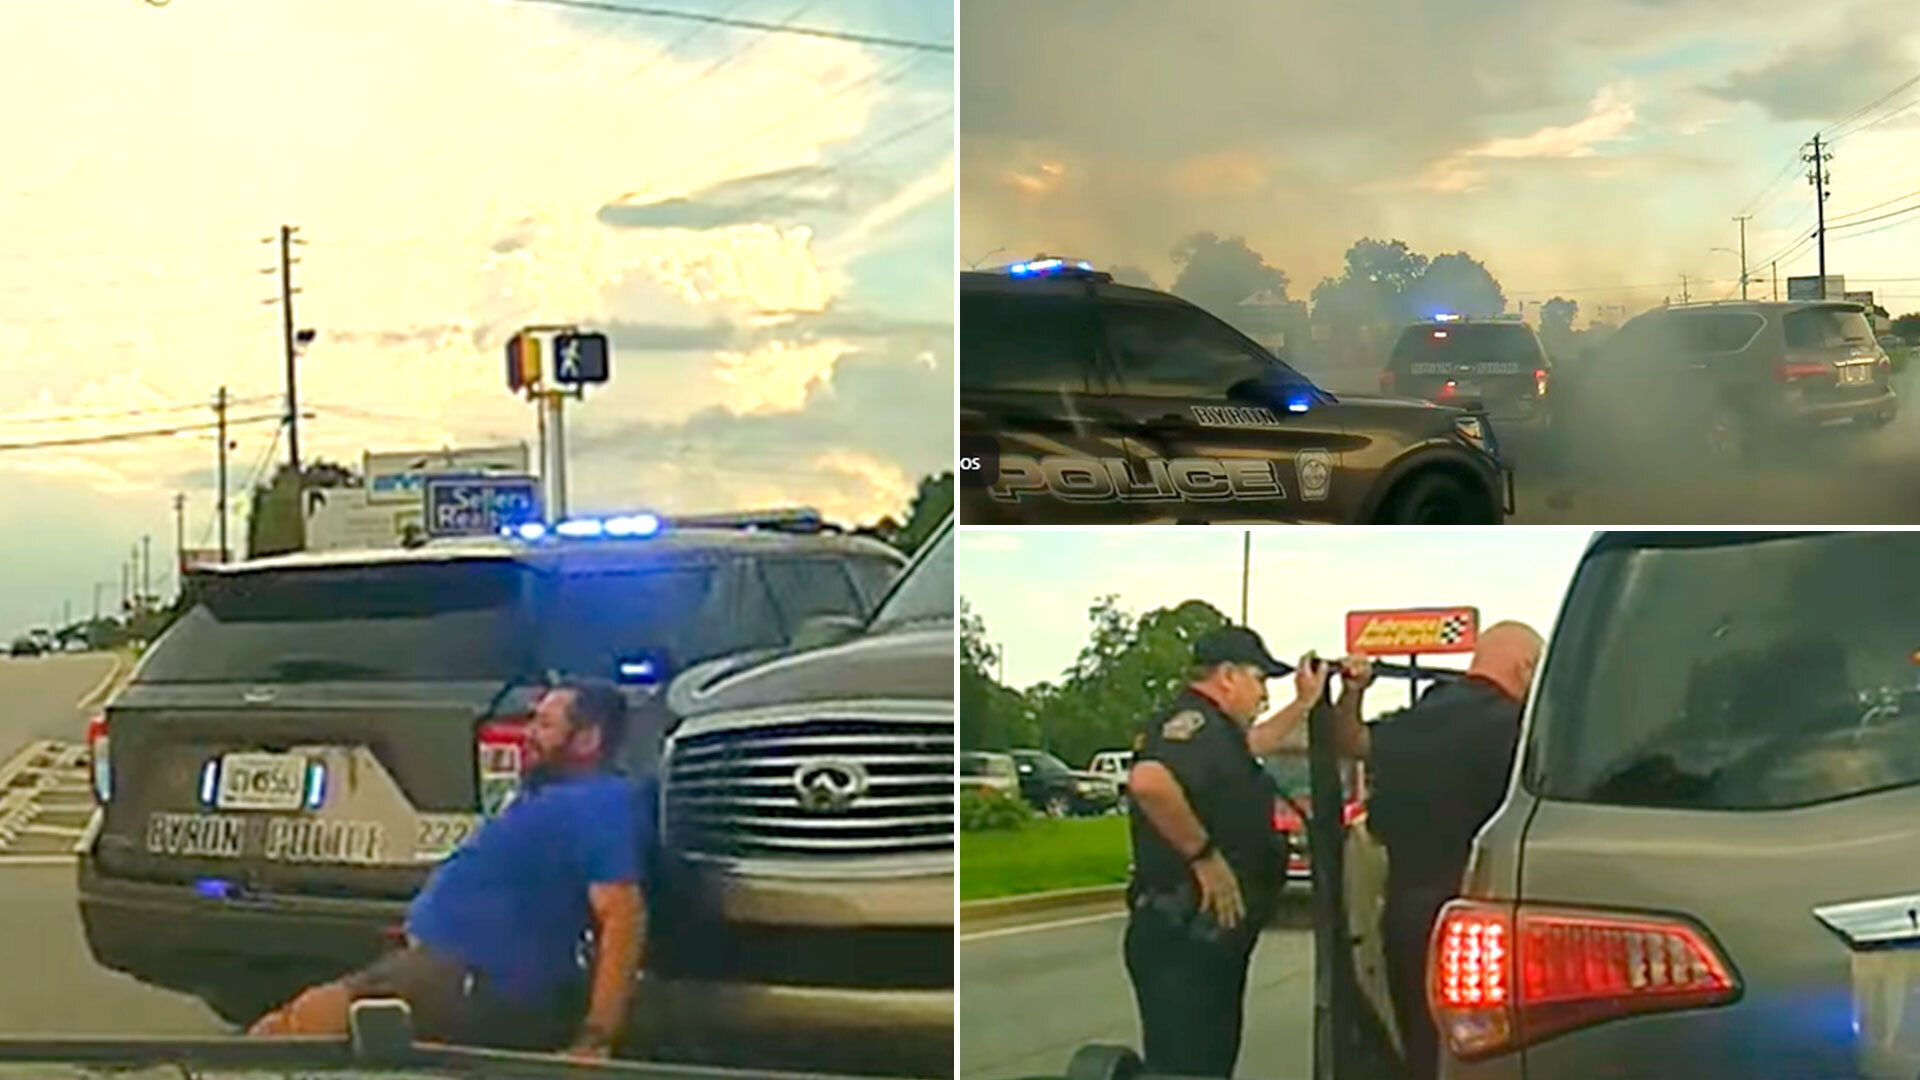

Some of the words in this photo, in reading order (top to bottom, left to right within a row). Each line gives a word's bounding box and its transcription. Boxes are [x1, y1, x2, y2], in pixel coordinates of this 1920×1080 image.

[1190, 405, 1280, 426] BYRON
[990, 456, 1286, 503] POLICE
[148, 813, 242, 856] BYRON
[266, 818, 386, 863] POLICE
